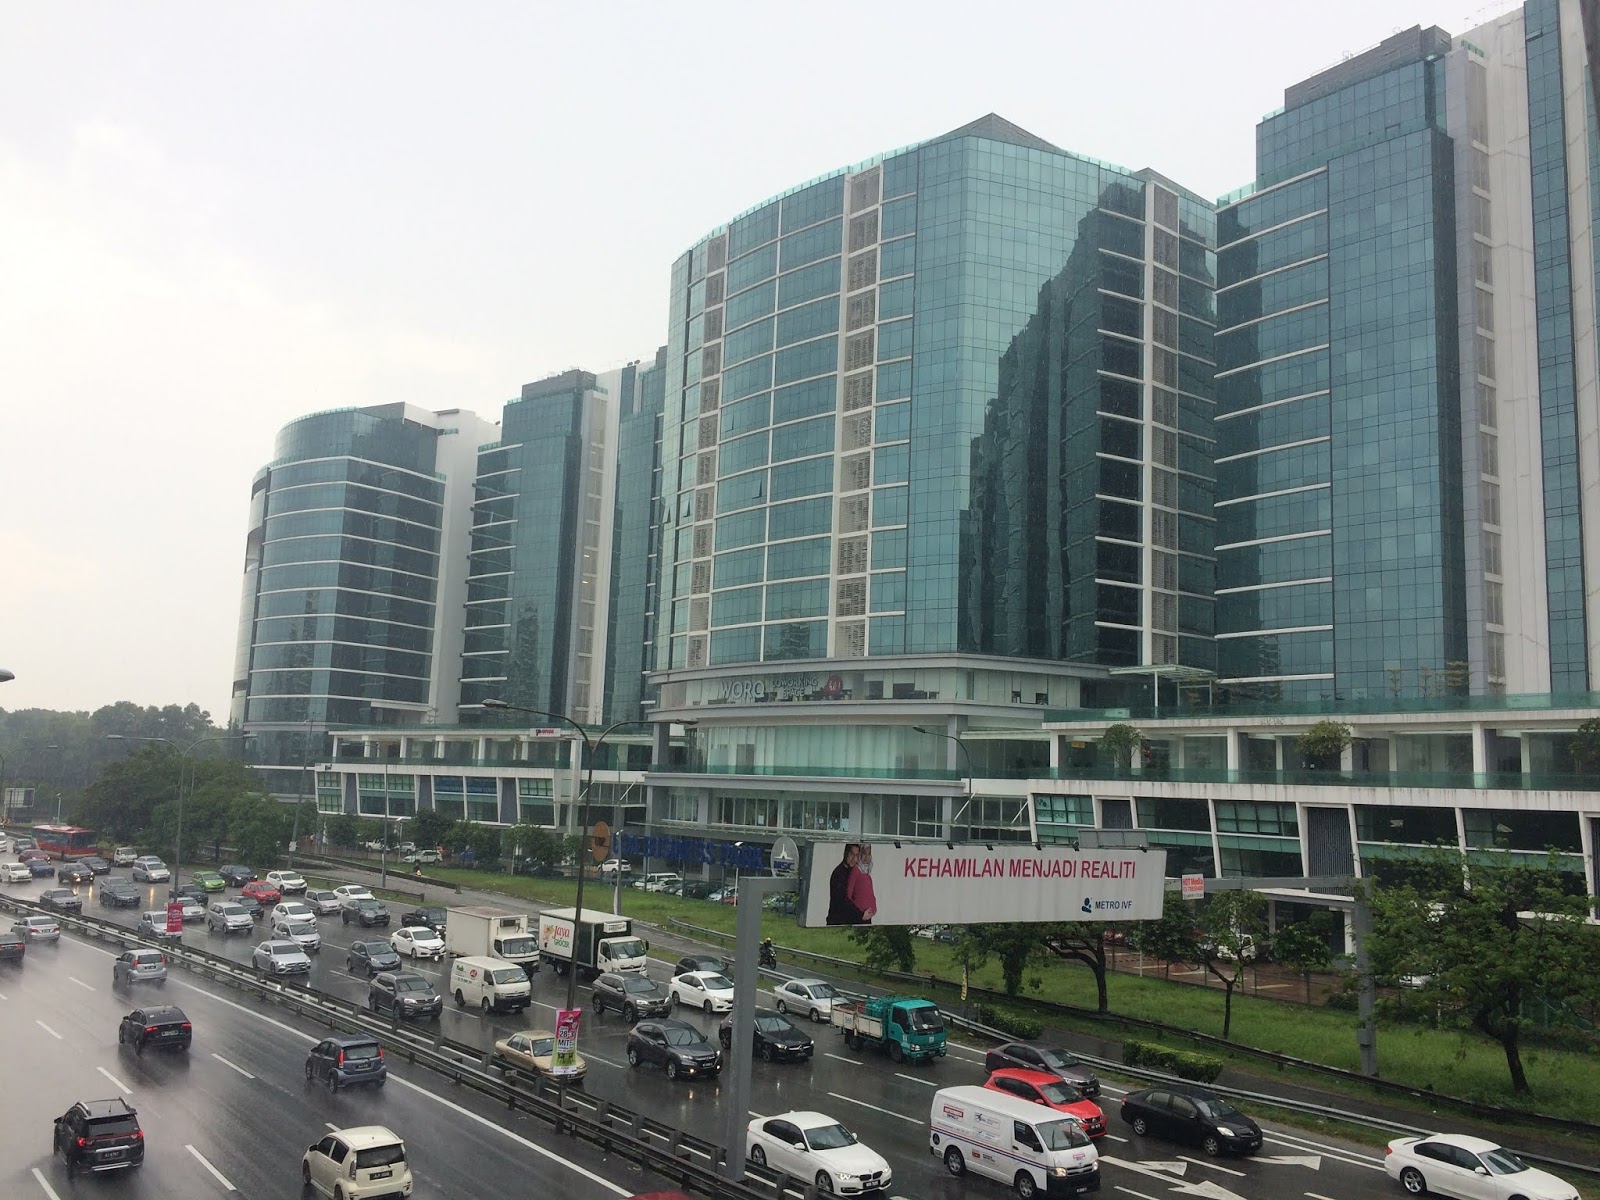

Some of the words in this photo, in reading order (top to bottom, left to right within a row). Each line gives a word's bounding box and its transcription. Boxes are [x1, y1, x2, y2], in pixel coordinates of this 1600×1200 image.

[772, 676, 818, 688] COWORKING
[783, 688, 805, 697] SPACE
[904, 857, 1004, 878] KEHAMILAN
[1009, 859, 1077, 878] MENJADI
[1081, 860, 1136, 879] REALITI
[1095, 901, 1120, 909] METRO
[1121, 900, 1133, 909] IVF
